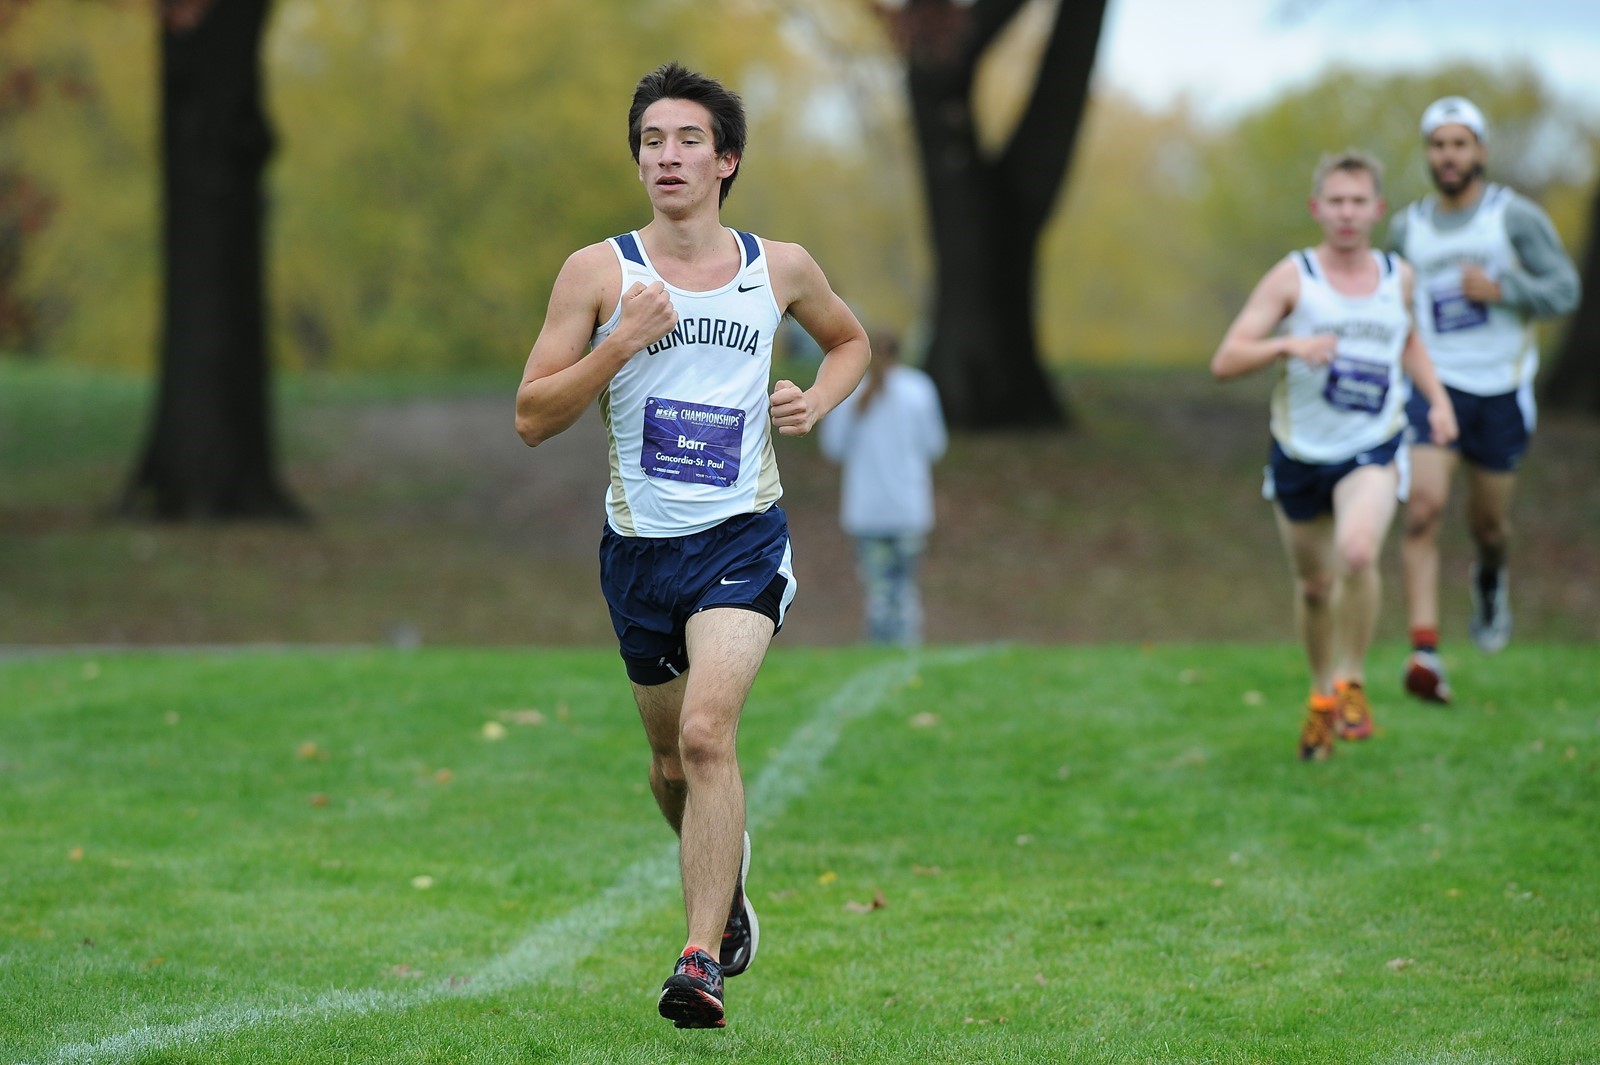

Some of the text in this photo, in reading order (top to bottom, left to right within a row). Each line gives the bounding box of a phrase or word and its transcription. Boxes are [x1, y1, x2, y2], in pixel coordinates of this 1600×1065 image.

[680, 408, 740, 427] CHAMPIONSHIPS
[677, 434, 707, 451] Barr
[655, 452, 725, 469] Concordia-St. Paul
